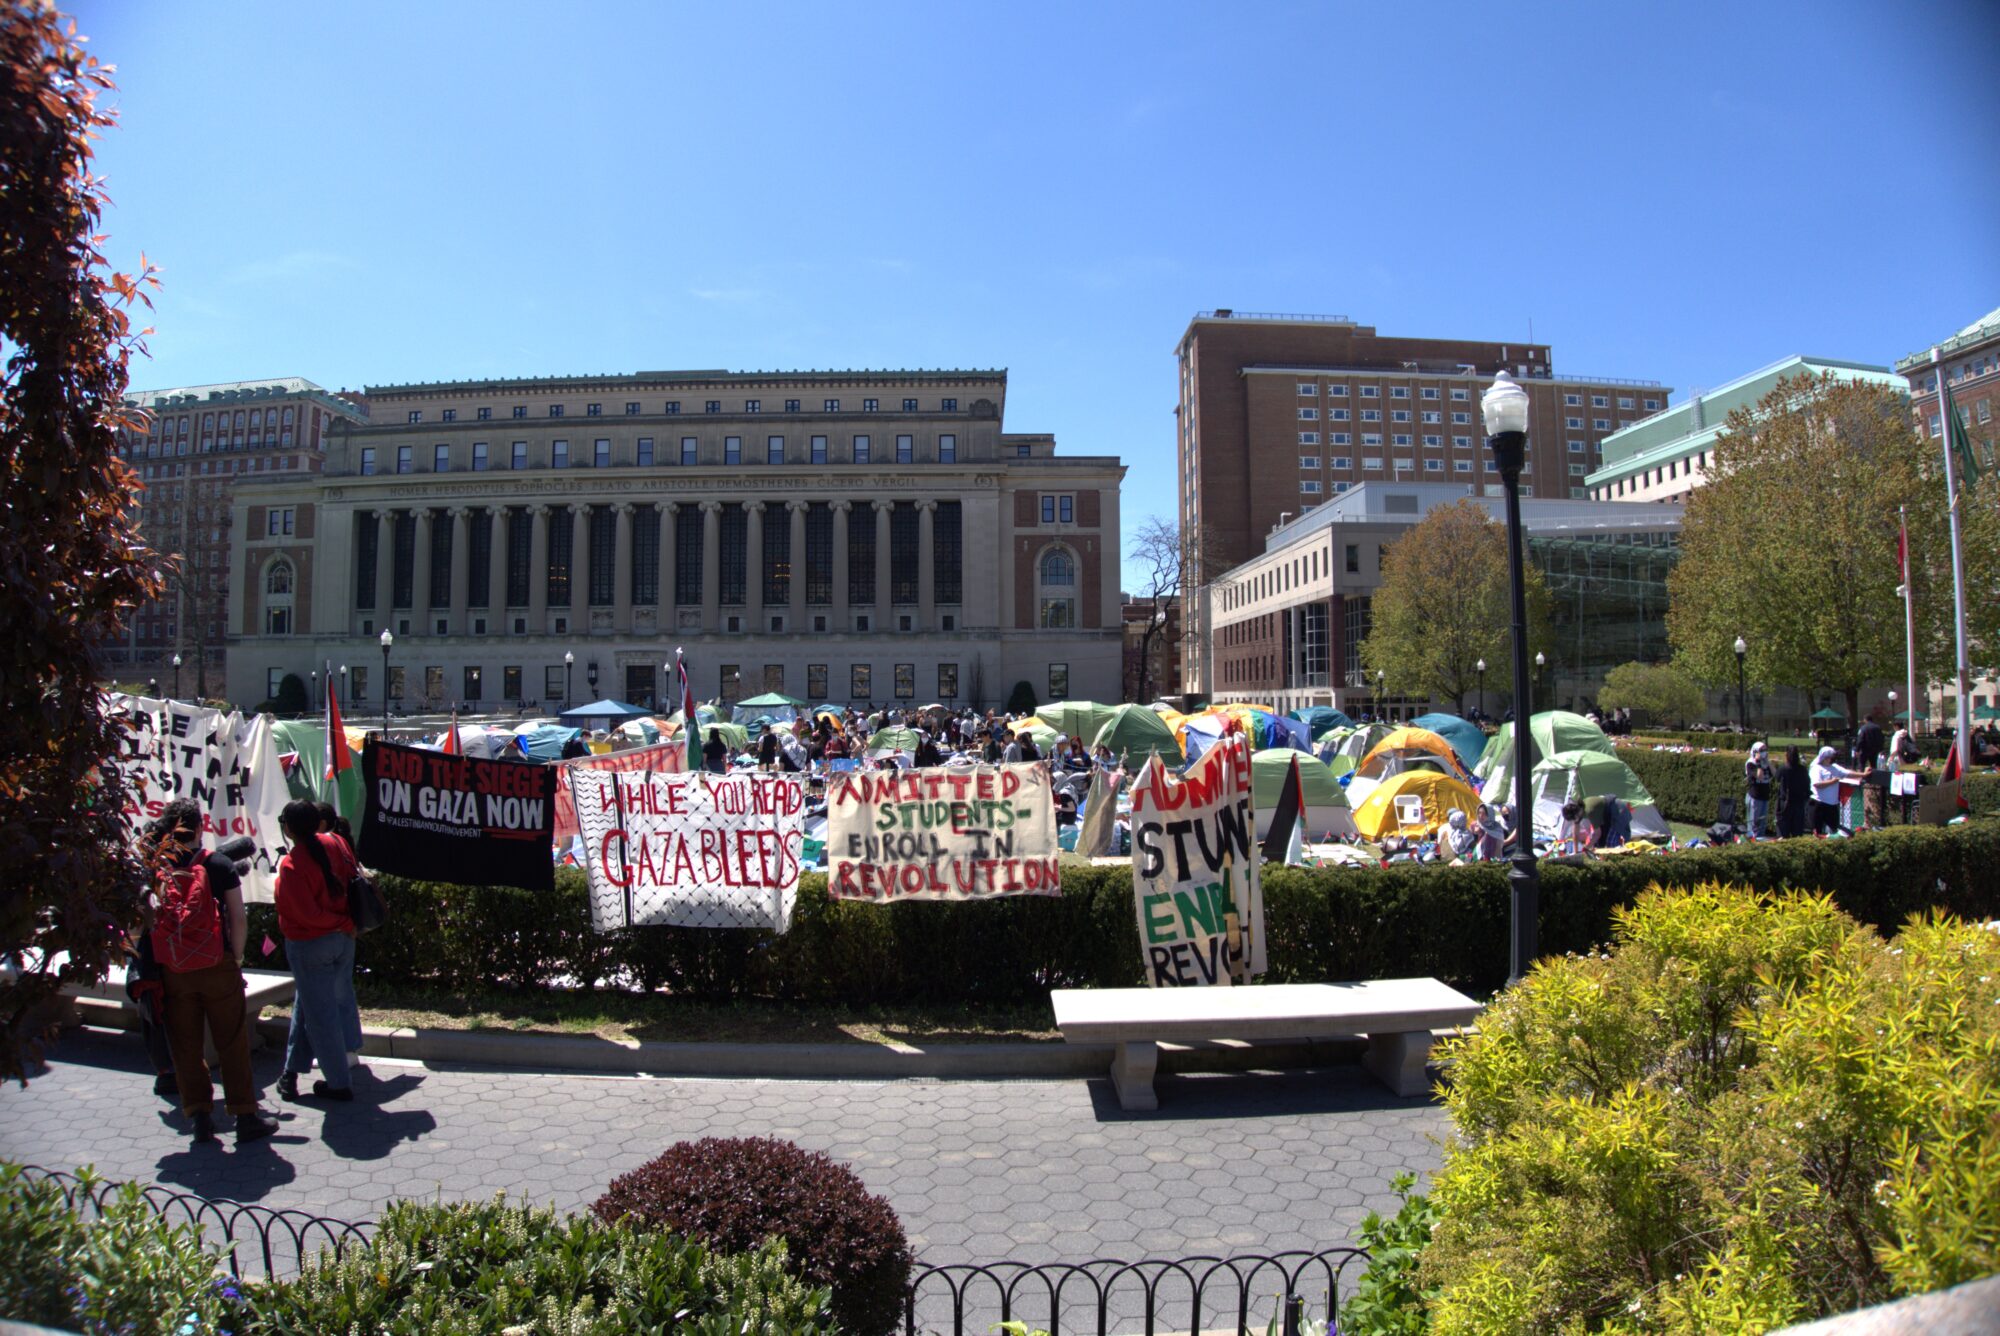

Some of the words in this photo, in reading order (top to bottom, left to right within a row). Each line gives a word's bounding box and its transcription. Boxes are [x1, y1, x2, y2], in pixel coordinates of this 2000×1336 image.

[389, 486, 428, 497] HOMER
[436, 484, 505, 496] HERODOTUS
[513, 482, 584, 493] SOPHOCLES
[642, 479, 710, 489] ARISTOTLE
[716, 479, 808, 488] DEMOSTHENES
[817, 478, 864, 488] CICERO
[873, 478, 916, 488] VERGIL
[375, 747, 423, 784] END
[428, 758, 472, 791] THE
[475, 761, 545, 798] SIEGE
[836, 770, 1021, 806] ADMITTED
[378, 778, 412, 814] ON
[418, 786, 480, 825] GAZA
[487, 794, 544, 829] NOW
[600, 783, 688, 815] WHILE
[704, 780, 745, 815] YOU
[751, 779, 800, 816] READ
[601, 829, 697, 887] GAZA
[700, 829, 801, 889] BLEEDS
[848, 832, 948, 863] ENROLL
[965, 829, 1014, 859] IN
[837, 858, 1060, 897] REVOLUTION
